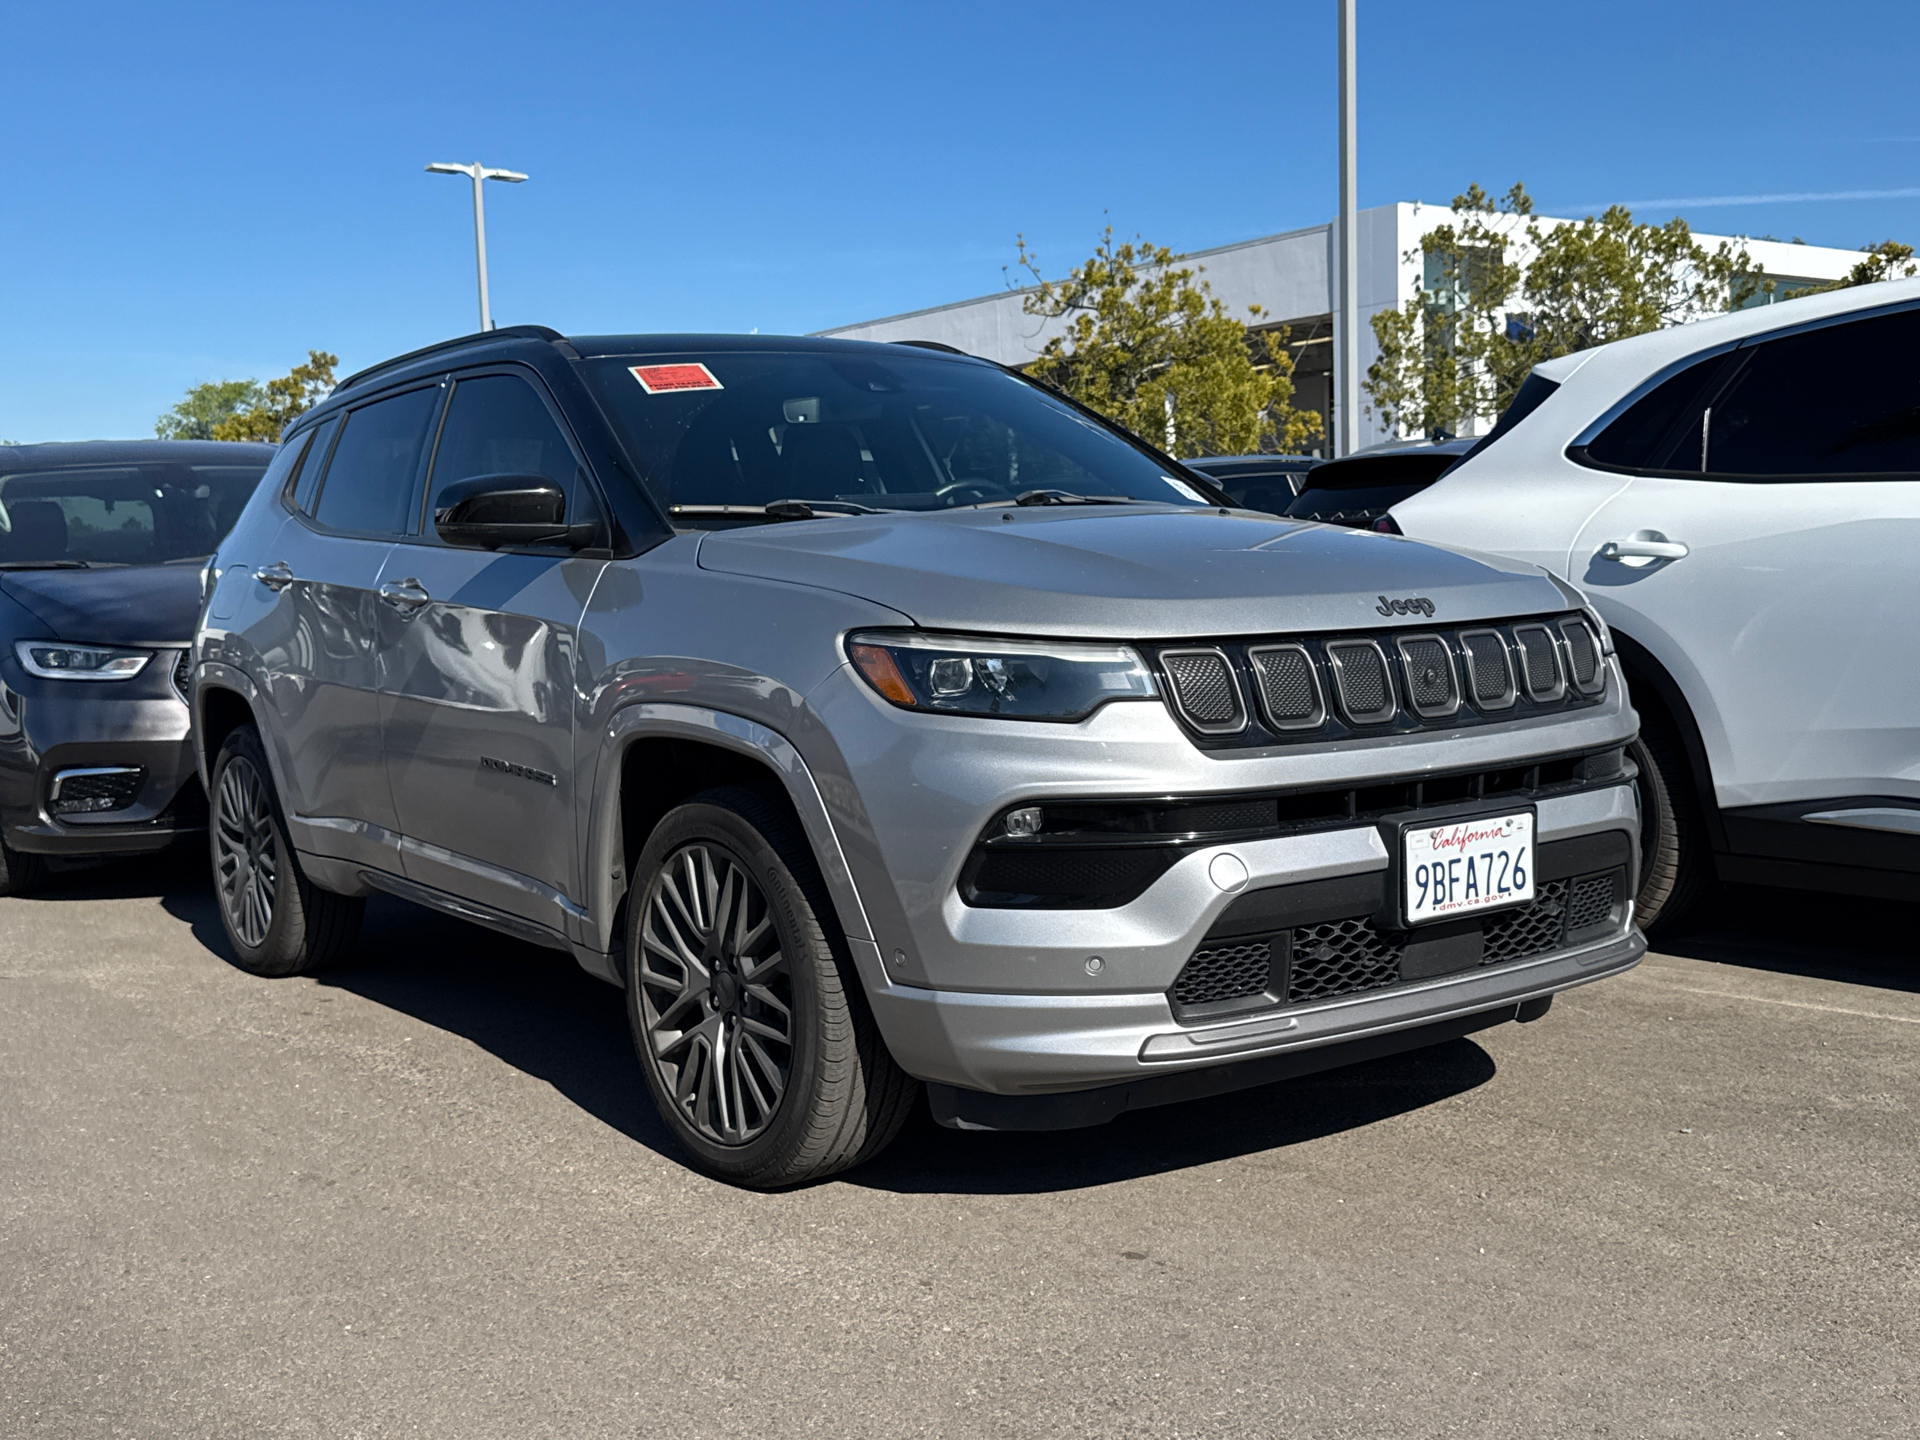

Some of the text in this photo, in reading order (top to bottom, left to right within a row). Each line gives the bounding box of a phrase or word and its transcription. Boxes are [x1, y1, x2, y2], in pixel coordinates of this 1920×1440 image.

[1375, 595, 1436, 618] Jeep
[1431, 824, 1511, 853] California
[1415, 846, 1527, 910] 9BFA726
[766, 865, 806, 951] Continental
[1439, 892, 1506, 911] dmv.ca.gov
